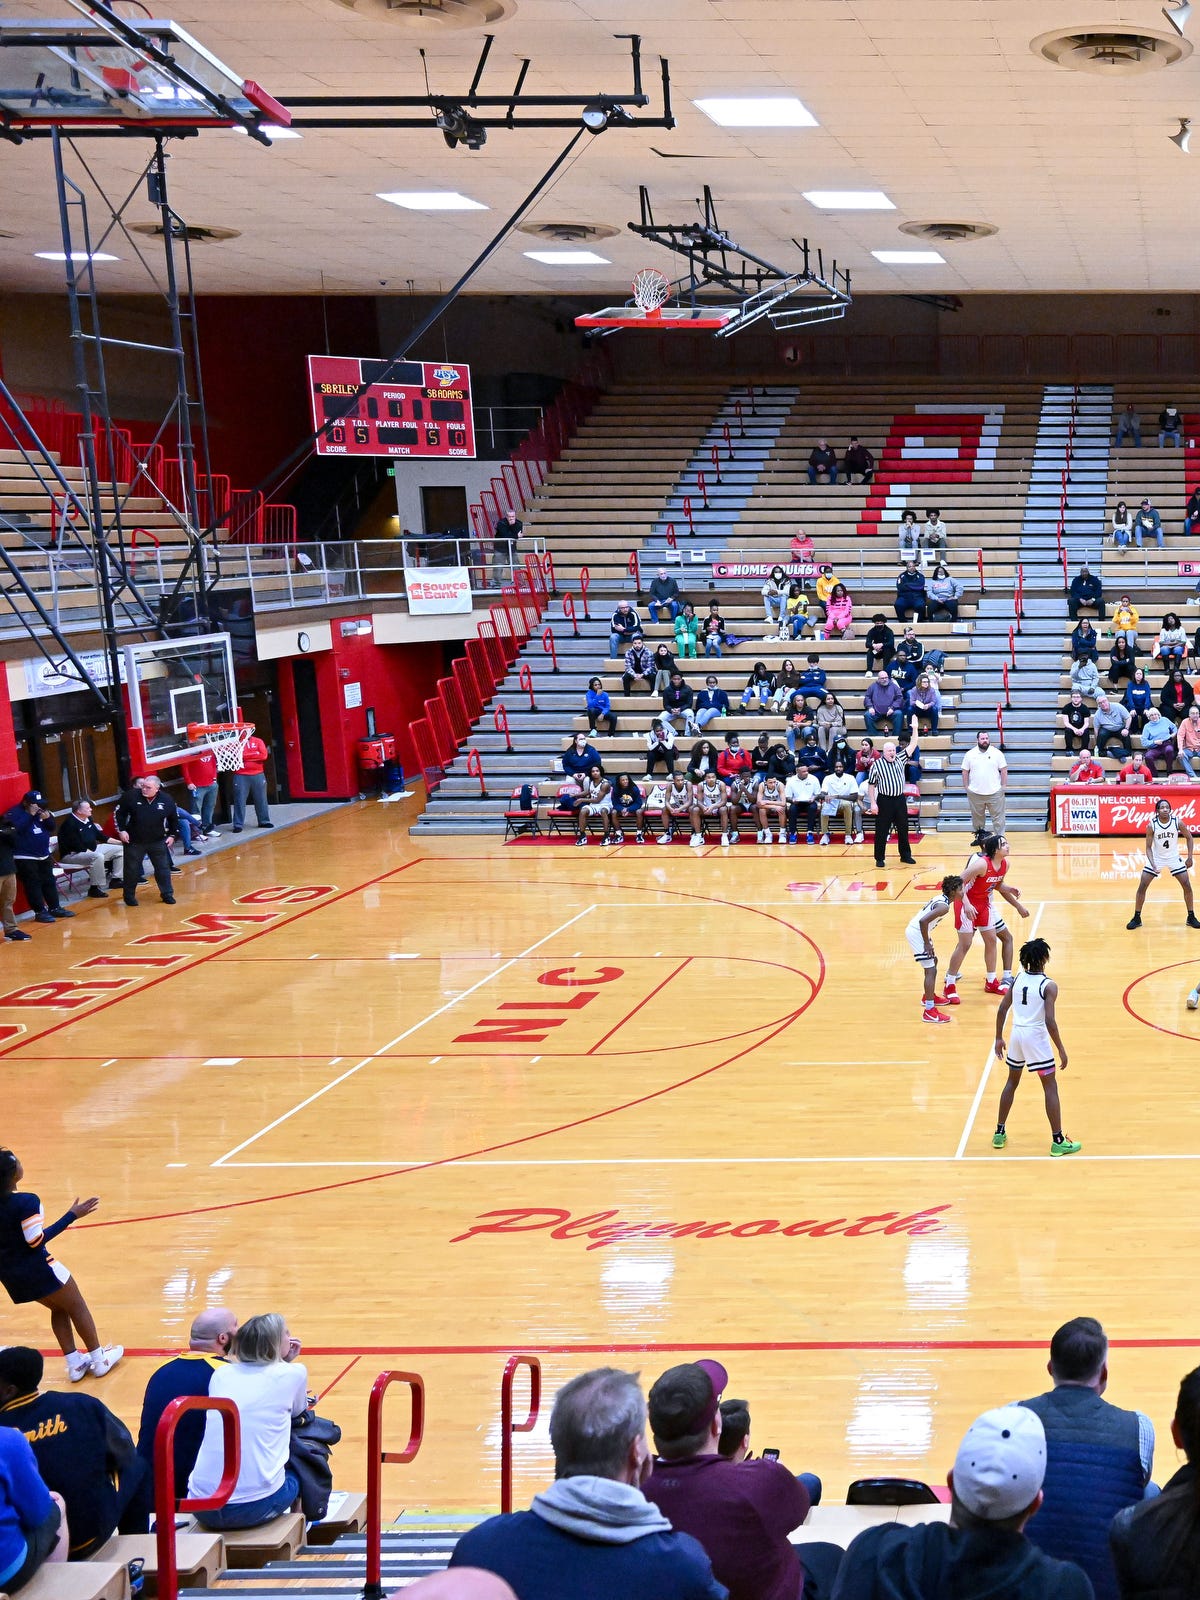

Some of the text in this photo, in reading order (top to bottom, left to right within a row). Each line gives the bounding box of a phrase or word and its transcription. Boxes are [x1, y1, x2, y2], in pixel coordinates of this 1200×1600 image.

[334, 428, 343, 442] 0
[357, 429, 366, 442] 5
[429, 431, 438, 444] 5
[455, 432, 464, 445] 0
[733, 565, 767, 575] HOME
[784, 564, 814, 575] DULTS
[1184, 564, 1192, 573] B
[423, 582, 467, 591] Source
[424, 591, 458, 599] Bank
[1099, 796, 1161, 804] WELCOME TO
[1071, 810, 1097, 819] WTCA
[1157, 831, 1175, 839] RILEY
[1162, 840, 1170, 849] 4
[0, 884, 340, 1043] RIMS
[1021, 986, 1029, 1005] 1
[451, 966, 624, 1042] NLC
[449, 1204, 953, 1250] Plymouth
